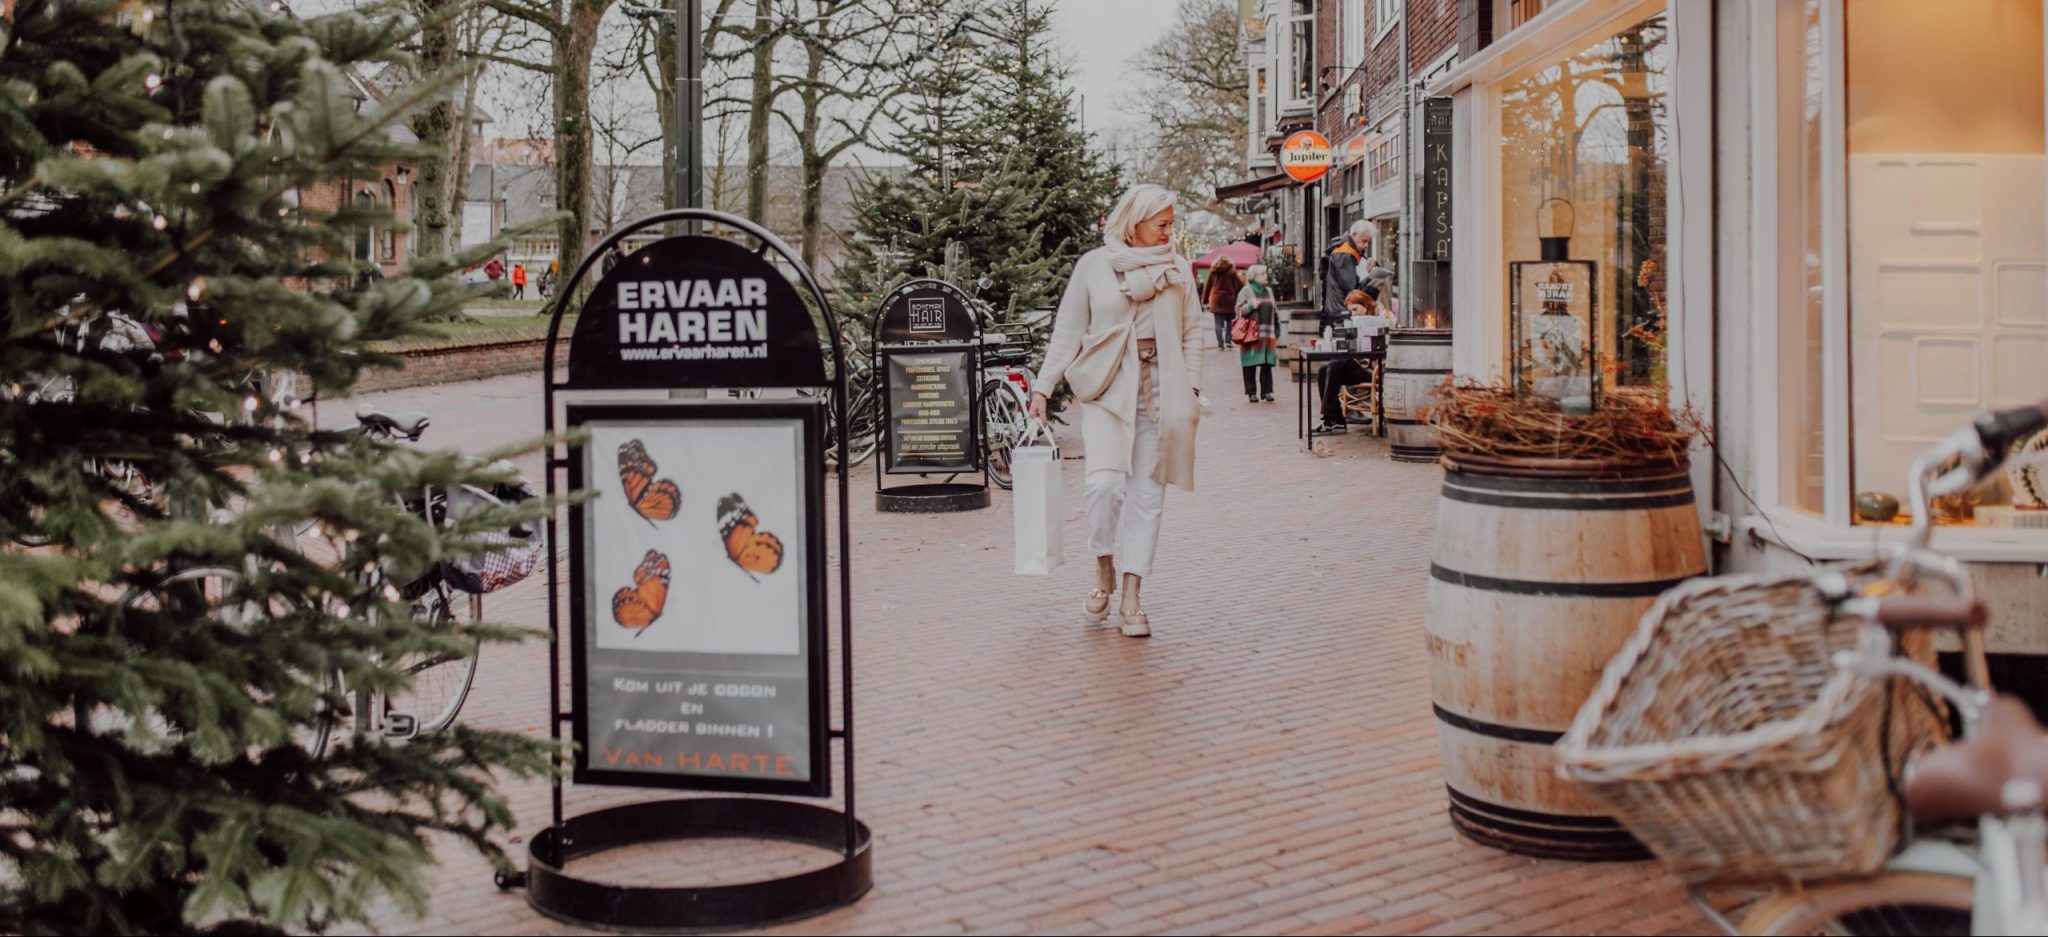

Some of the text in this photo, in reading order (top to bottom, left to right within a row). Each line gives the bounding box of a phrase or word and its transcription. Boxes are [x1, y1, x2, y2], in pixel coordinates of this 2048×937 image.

[1288, 151, 1328, 163] Jupiler
[617, 278, 767, 310] ERVAAR
[910, 310, 943, 322] HAIR
[618, 310, 768, 343] HAREN
[620, 342, 768, 361] www.ervaarharen.nl
[613, 677, 649, 693] KOM
[655, 681, 683, 694] UIT
[688, 682, 708, 696] JE
[680, 702, 703, 715] EN
[615, 718, 689, 734] FLADDER
[696, 723, 760, 738] BINNEN
[604, 745, 795, 777] VAN HARTE
